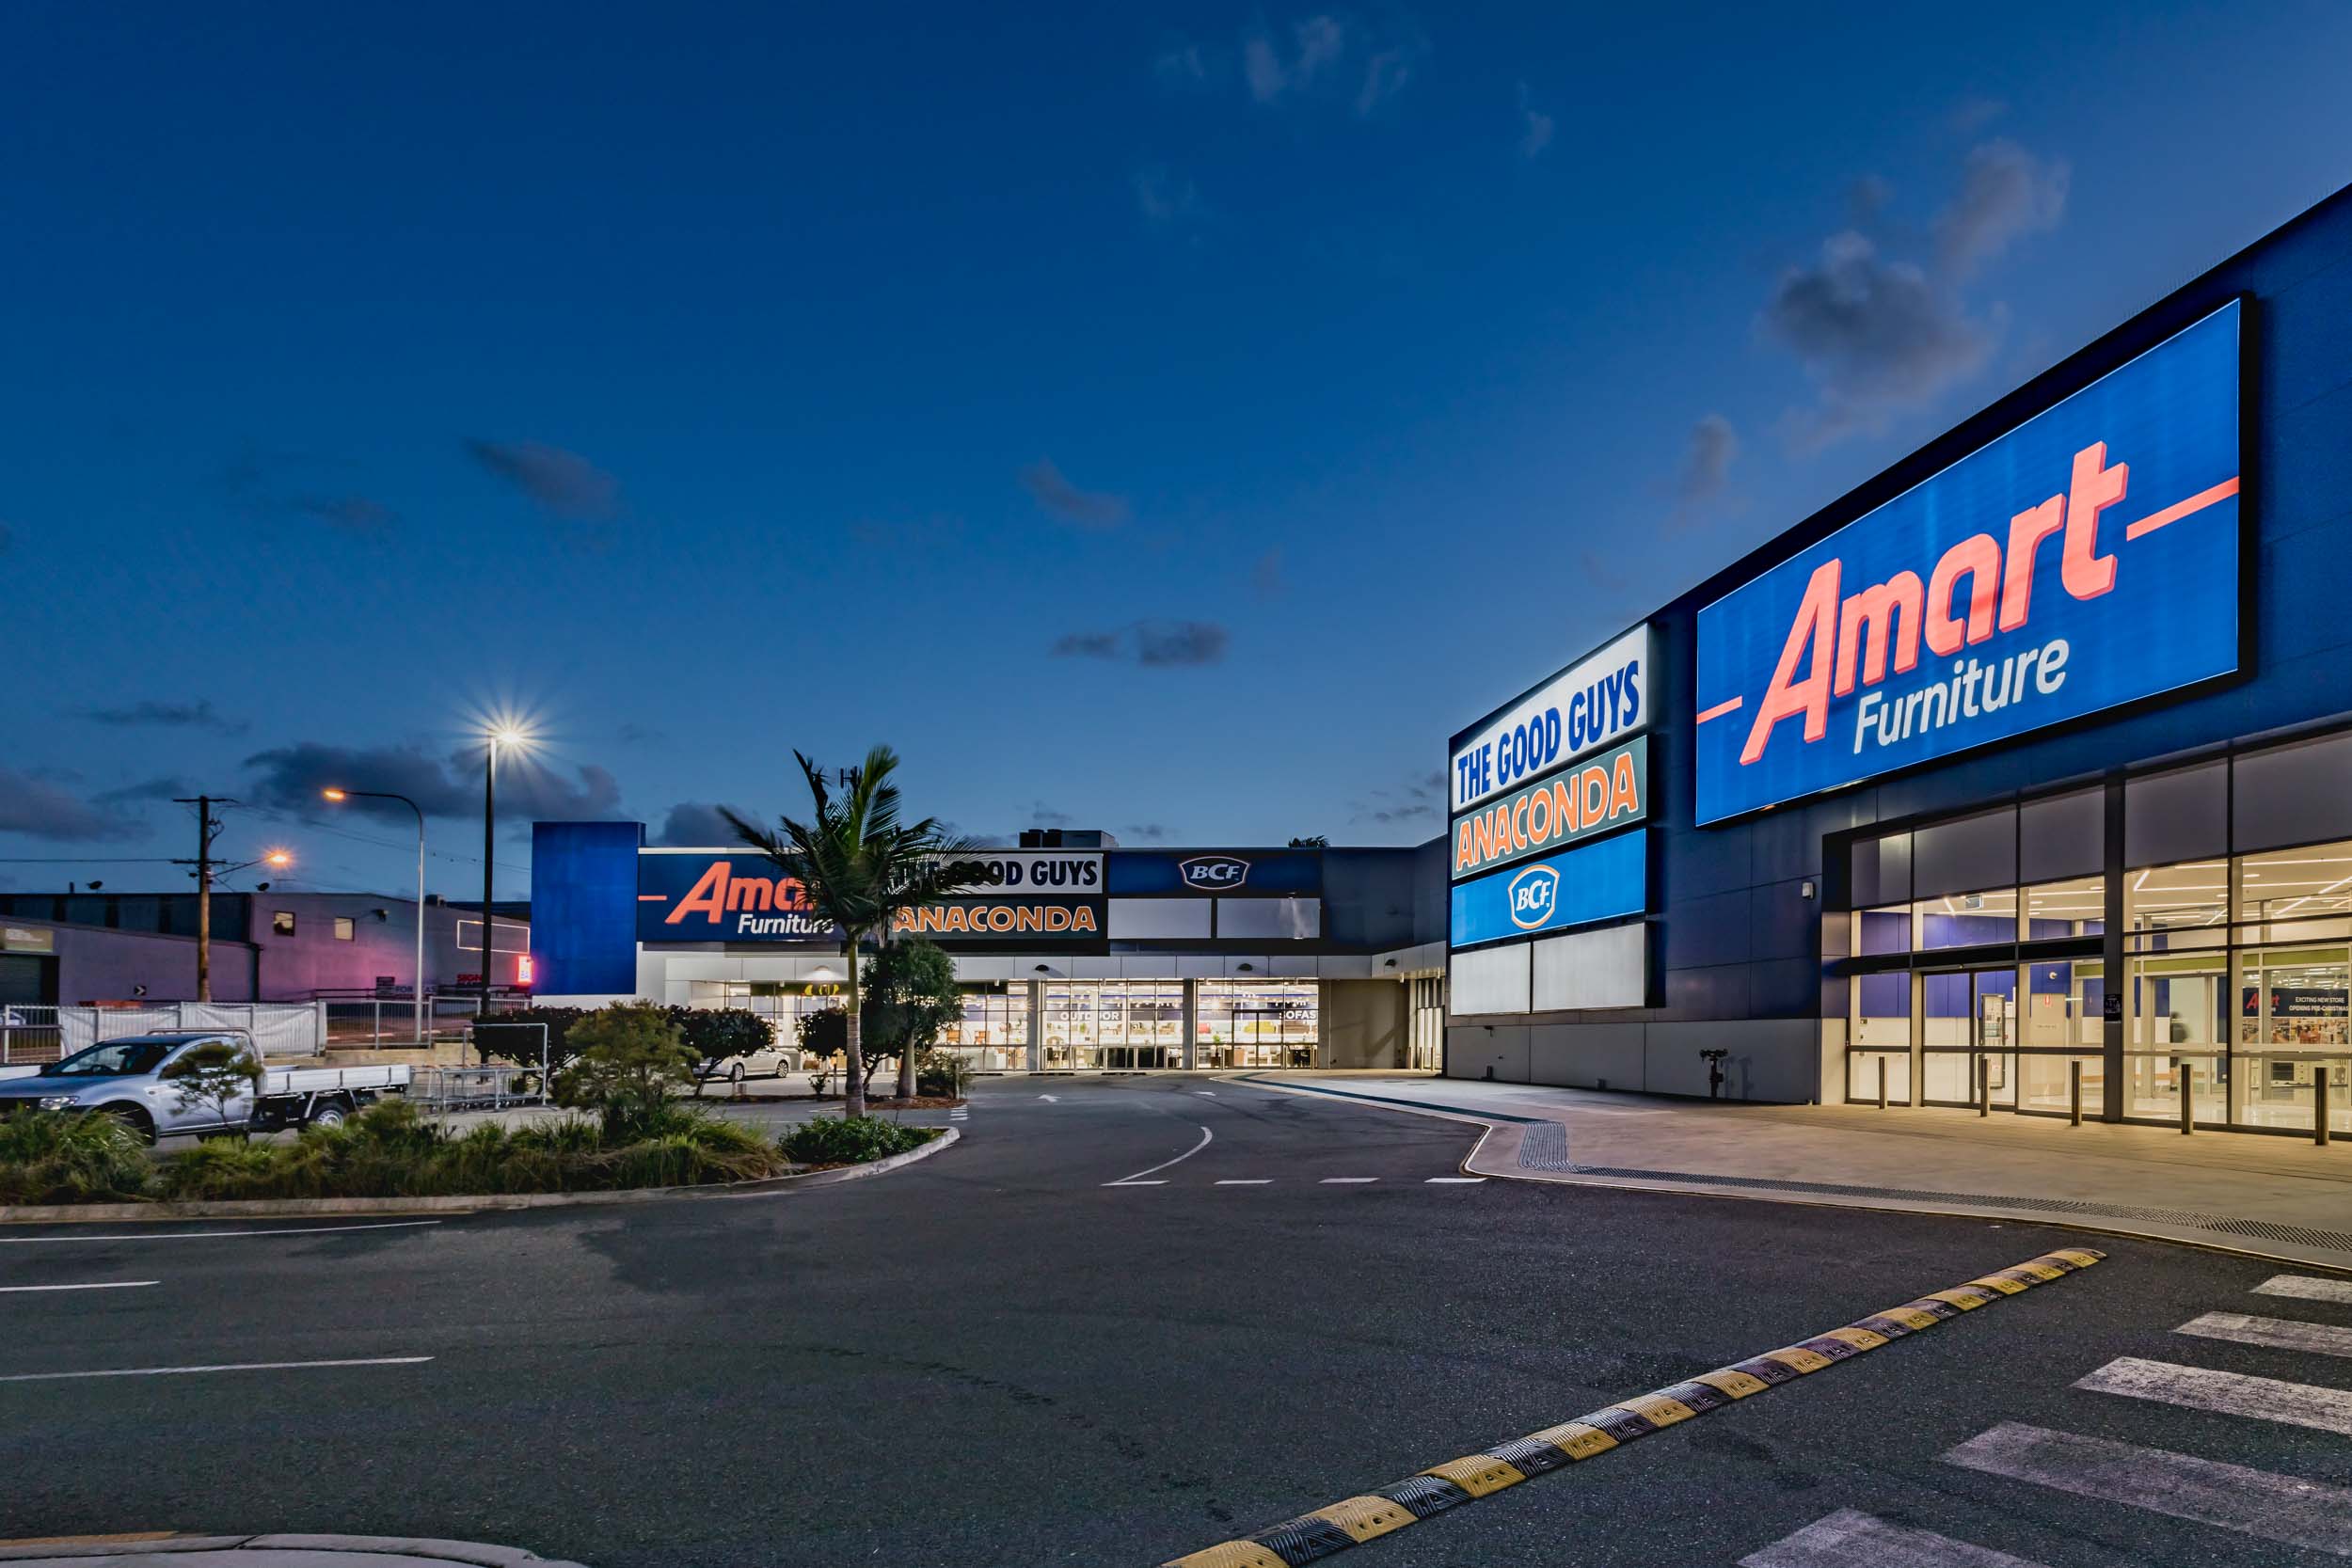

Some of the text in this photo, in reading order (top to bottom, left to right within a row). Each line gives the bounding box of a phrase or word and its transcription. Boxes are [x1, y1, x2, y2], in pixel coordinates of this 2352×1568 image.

[1739, 440, 2129, 766] Amart
[1853, 638, 2069, 754] Furniture
[1458, 659, 1639, 804] THE GOOD GUYS
[1455, 752, 1639, 872] ANACONDA
[1030, 860, 1098, 886] GUYS
[1190, 863, 1240, 880] BCF
[664, 861, 819, 924] Ama
[1516, 879, 1551, 911] BCF
[893, 906, 1097, 932] ANACONDA
[1060, 1011, 1120, 1021] OUTDOR
[1279, 1010, 1316, 1020] OFAS
